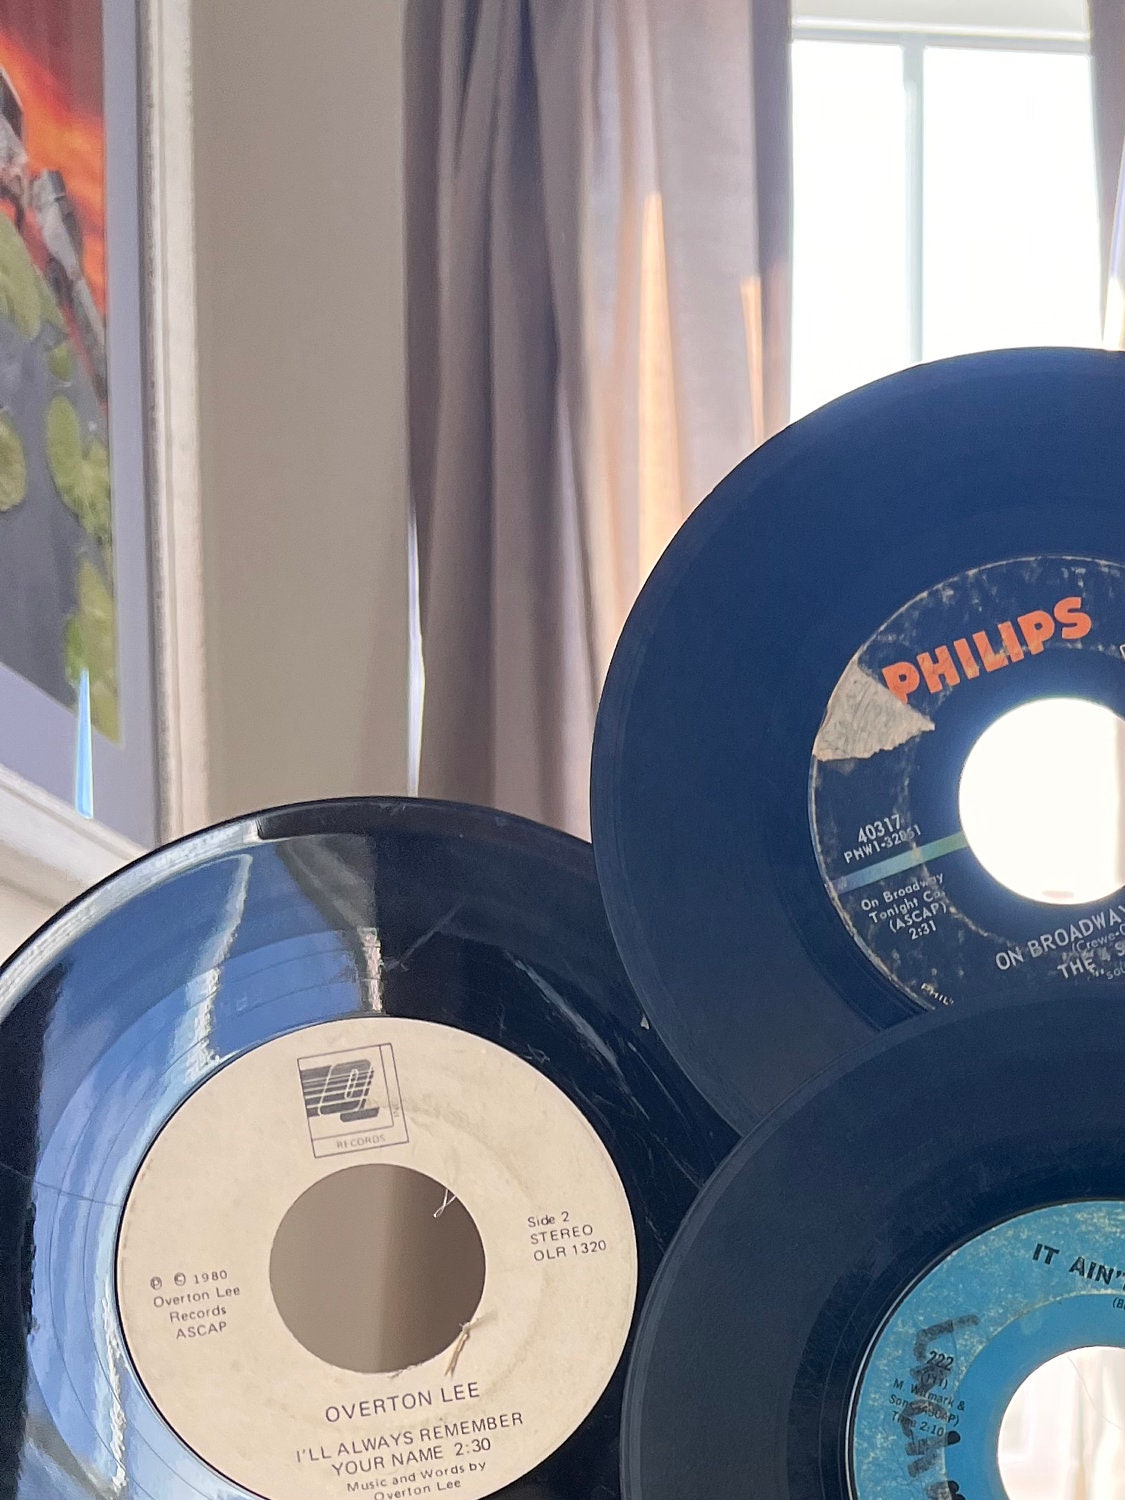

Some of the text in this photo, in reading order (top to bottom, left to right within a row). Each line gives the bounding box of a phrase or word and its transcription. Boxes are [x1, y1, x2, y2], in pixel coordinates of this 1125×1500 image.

[882, 596, 1092, 704] PHILIPS
[858, 814, 901, 843] 40317
[861, 873, 944, 911] On Broadway
[869, 899, 919, 923] Tonight
[890, 902, 947, 933] (ASCAP)
[909, 920, 937, 940] 2:31
[995, 946, 1023, 971] ON
[1057, 955, 1095, 980] THE
[336, 1135, 386, 1149] RECORDS
[528, 1211, 570, 1228] Side 2
[530, 1224, 593, 1245] STEREO
[534, 1240, 607, 1262] OLR 1320
[1032, 1242, 1060, 1265] IT
[194, 1269, 228, 1285] 1980
[153, 1286, 240, 1308] Overton Lee
[169, 1305, 227, 1323] Records
[176, 1321, 227, 1340] ASCAP
[926, 1350, 954, 1372] 222
[325, 1381, 481, 1423] OVERTON LEE
[296, 1411, 524, 1463] I'LL ALWAYS REMEMBER
[919, 1421, 945, 1437] 2:10
[331, 1437, 492, 1477] YOUR NAME 2:30
[347, 1461, 487, 1492] Music and Words by
[437, 1478, 462, 1491] Lee
